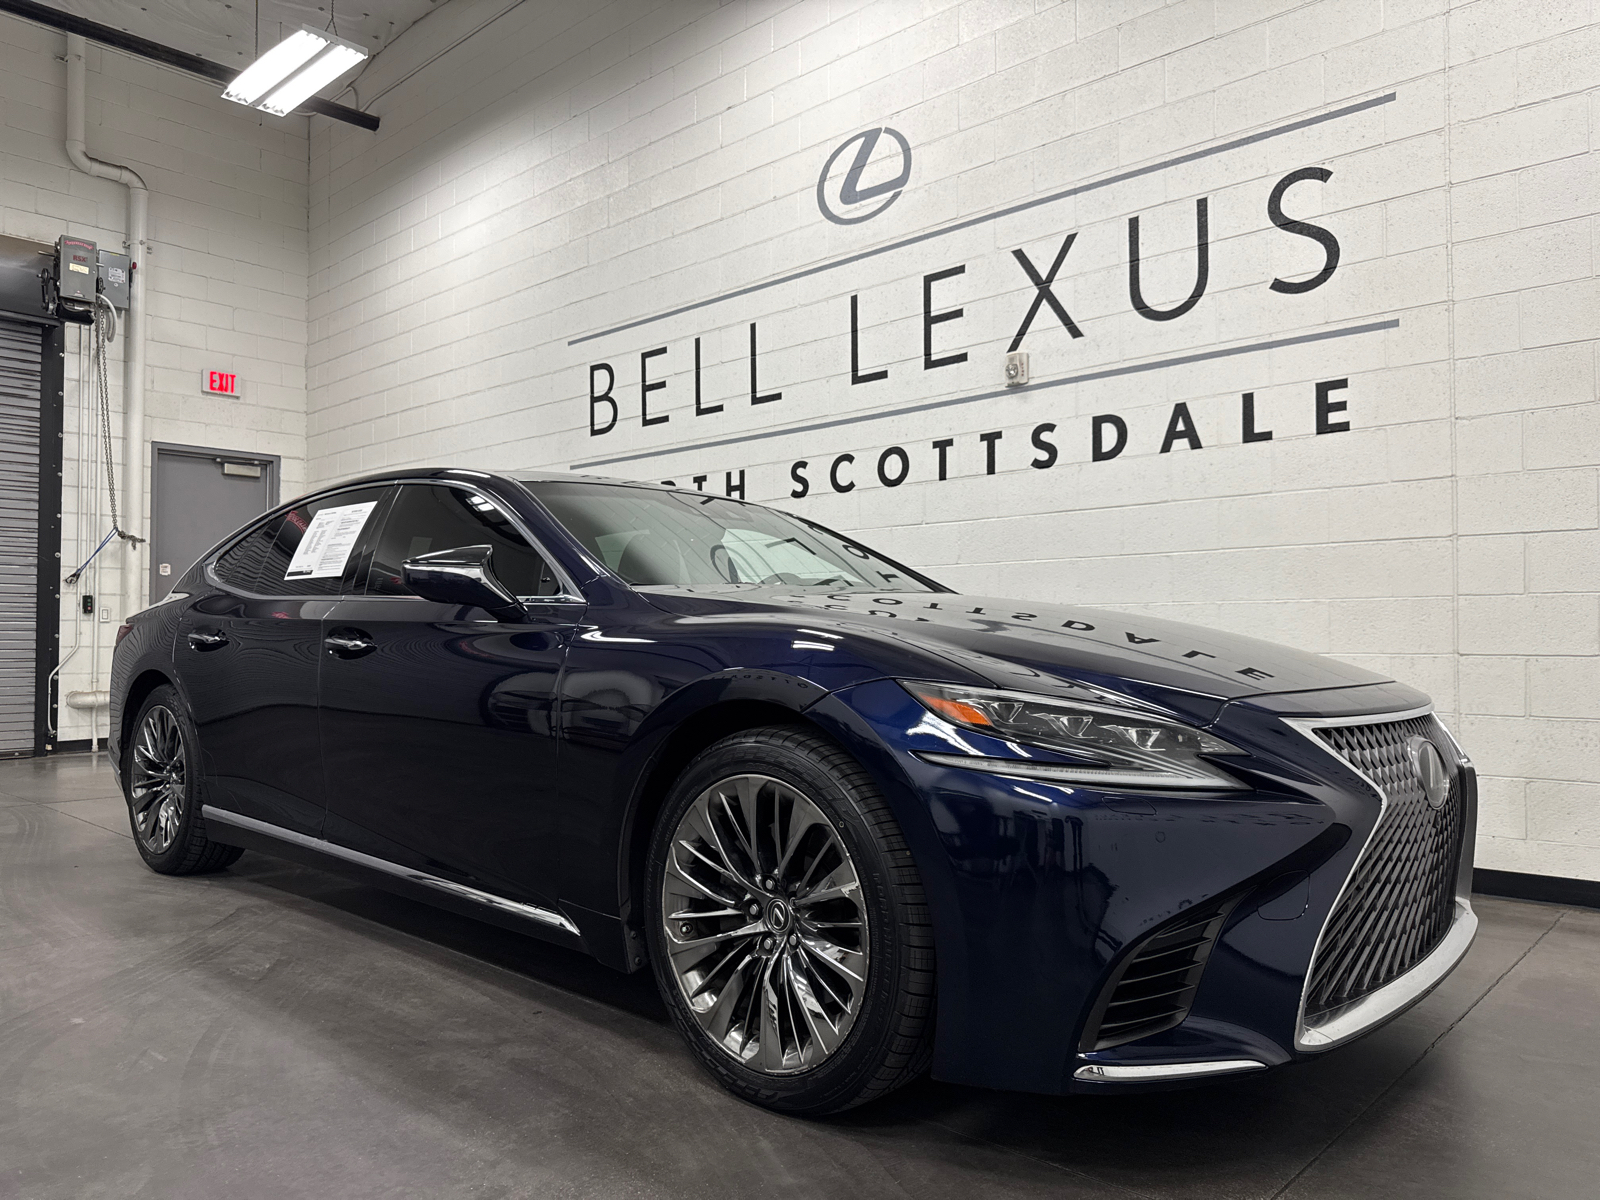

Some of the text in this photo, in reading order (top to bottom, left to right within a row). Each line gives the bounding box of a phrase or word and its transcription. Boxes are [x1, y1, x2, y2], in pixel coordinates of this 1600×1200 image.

[589, 166, 1341, 437] BELL LEXUS
[209, 370, 236, 394] EXIT
[790, 377, 1351, 499] SCOTTSDALE
